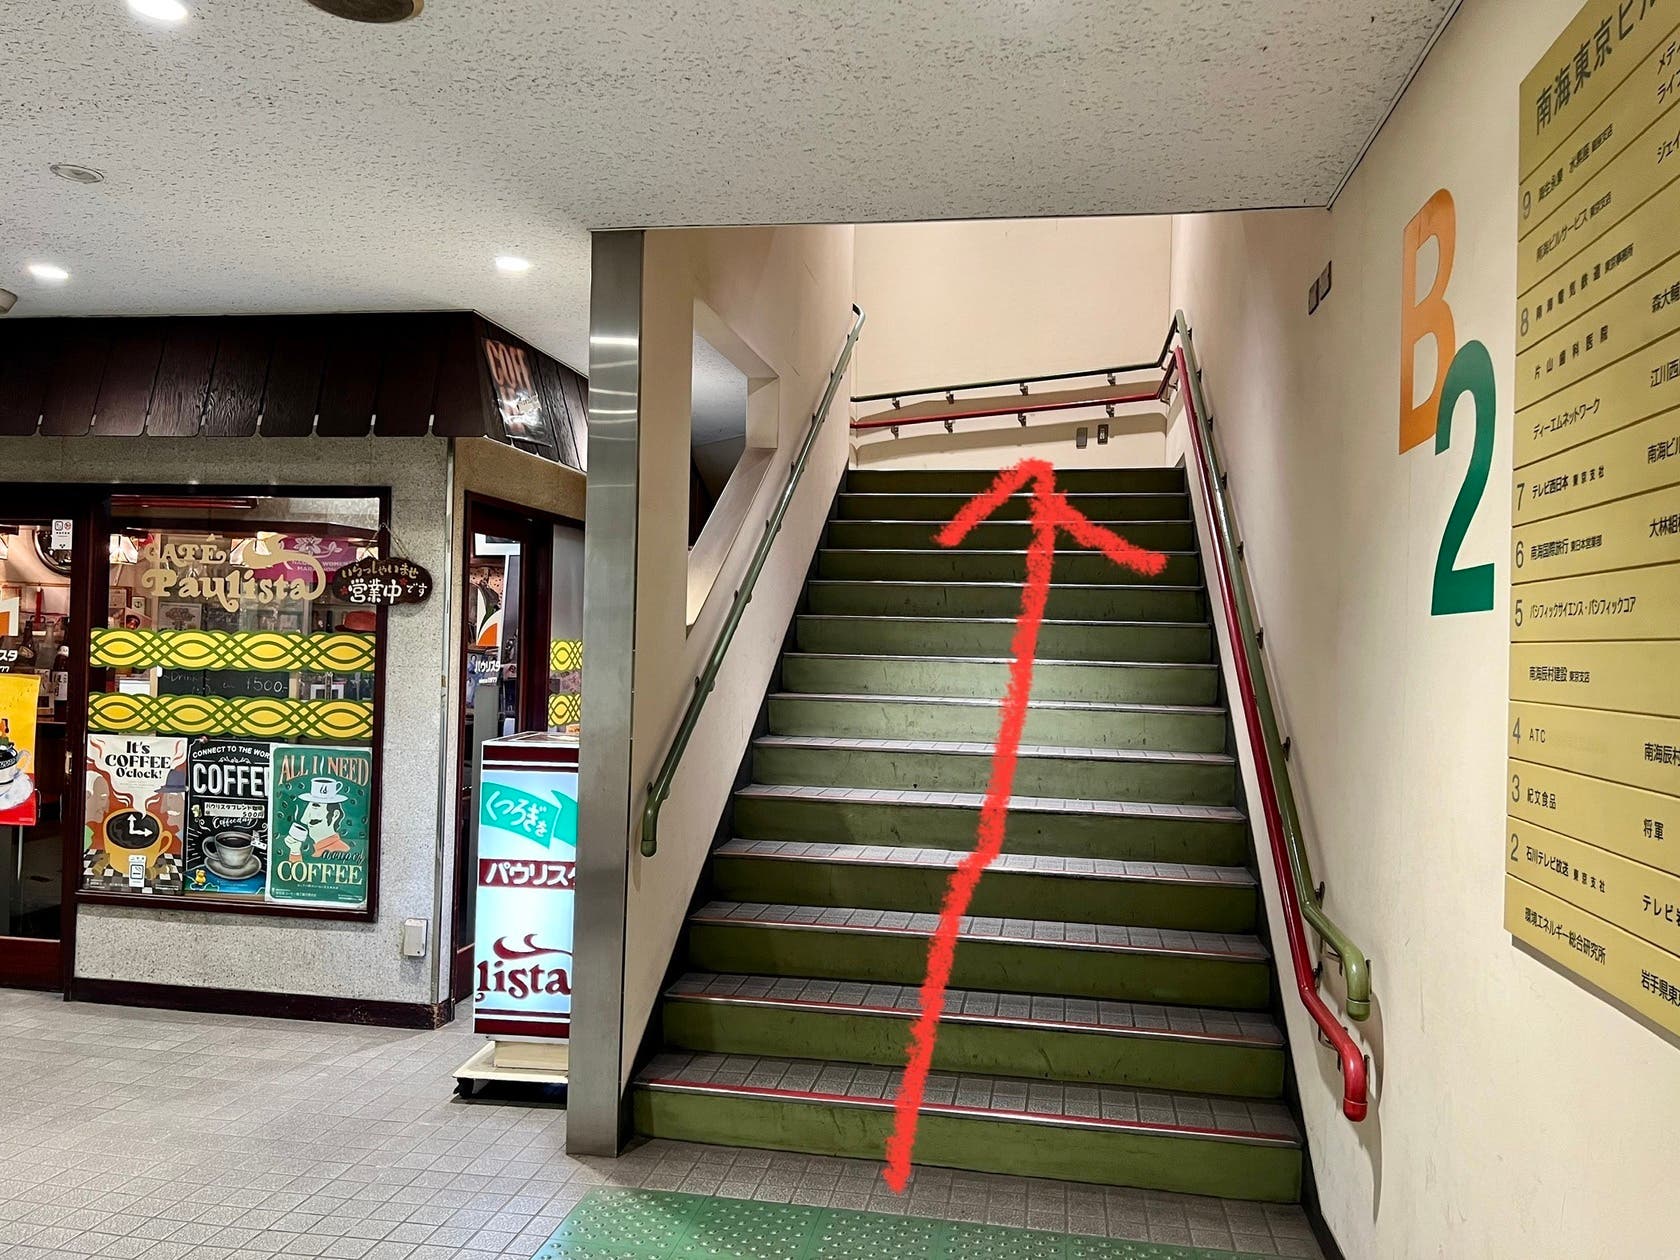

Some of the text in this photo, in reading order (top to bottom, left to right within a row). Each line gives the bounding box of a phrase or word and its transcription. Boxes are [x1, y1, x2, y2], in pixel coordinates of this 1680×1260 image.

[1522, 190, 1532, 220] 9
[1520, 307, 1529, 337] 8
[1533, 397, 1600, 440] ディーエムネットワーク
[1517, 465, 1605, 512] 7 テレビ西日本 東京支社
[1515, 540, 1524, 569] 6
[1530, 538, 1569, 561] 南海国際旅行
[342, 560, 419, 579] いらっしゃいませ
[142, 569, 315, 613] Paulista
[1514, 599, 1523, 627] 5
[1529, 666, 1568, 682] 南海辰村建設
[1512, 716, 1546, 745] 4 ATC
[105, 754, 171, 769] COFFEE
[126, 741, 150, 754] It's
[192, 746, 226, 758] CONNECT
[238, 746, 252, 754] THE
[116, 767, 162, 779] O'clock!
[278, 755, 369, 786] ALL I NEED
[1511, 774, 1556, 810] 3 紀文食品
[485, 791, 548, 838] くつろぎを
[1643, 818, 1664, 841] 将軍
[277, 861, 362, 885] COFFEE
[1510, 833, 1606, 894] 2 石川テレビ放送 東京支社
[1524, 906, 1606, 966] 環境エネルギー総合研究所
